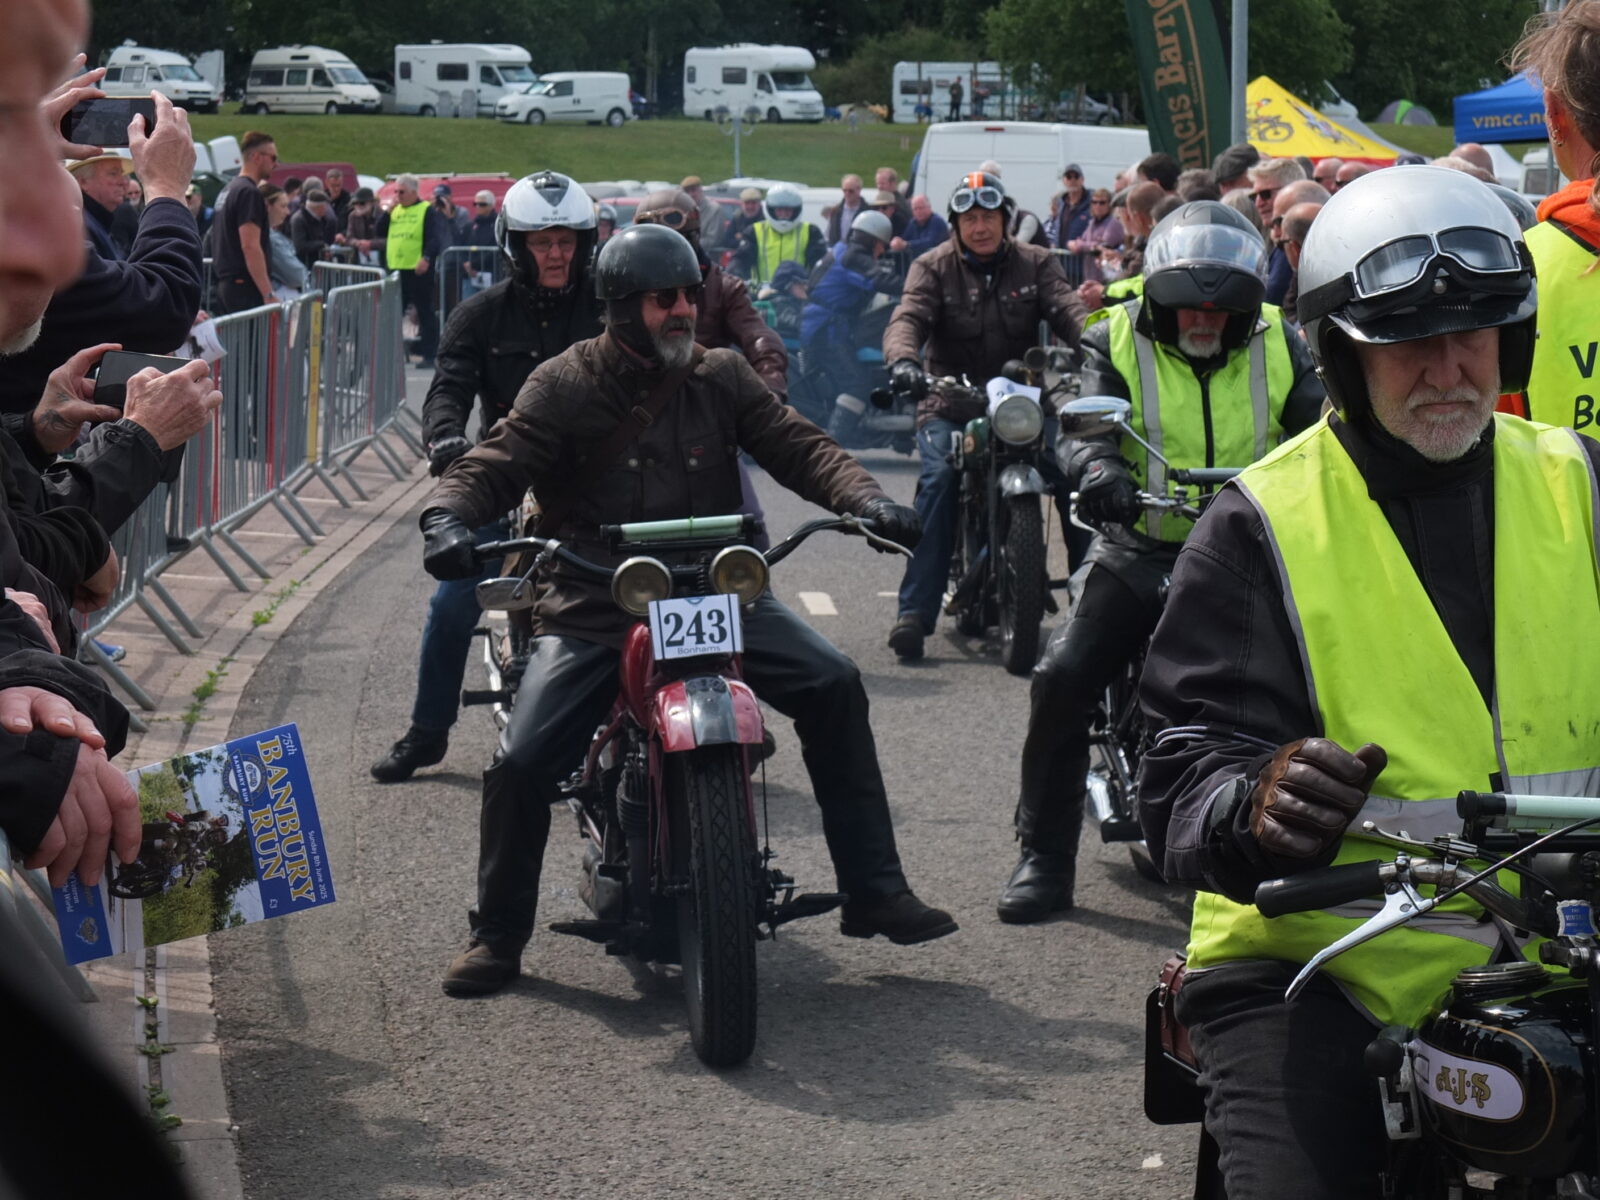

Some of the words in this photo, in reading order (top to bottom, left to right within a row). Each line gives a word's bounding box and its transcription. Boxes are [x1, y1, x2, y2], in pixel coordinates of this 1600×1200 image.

[663, 609, 727, 647] 243
[677, 646, 721, 655] Bonhams
[281, 732, 297, 756] 75th
[233, 755, 245, 786] BANBURY
[256, 735, 316, 903] BANBURY
[248, 804, 287, 881] RUN
[308, 830, 317, 855] Sunday
[315, 867, 323, 884] June
[318, 884, 328, 899] 2025
